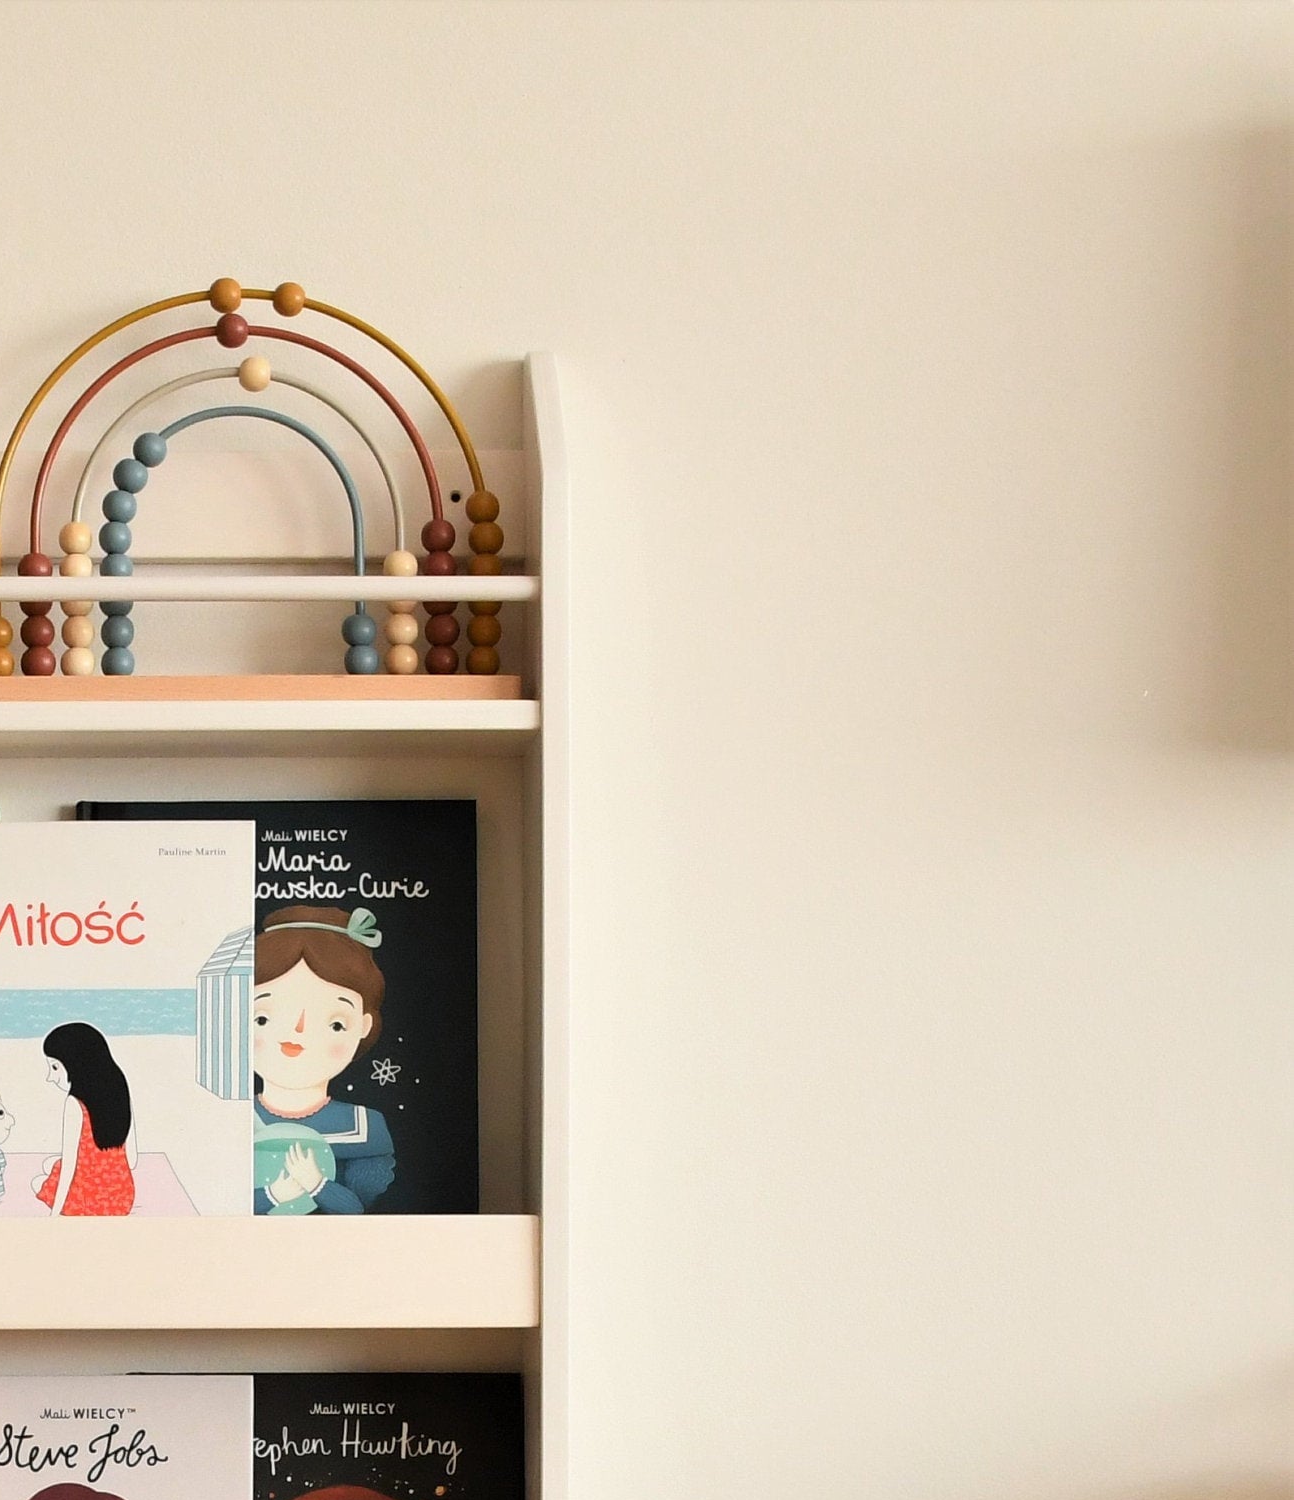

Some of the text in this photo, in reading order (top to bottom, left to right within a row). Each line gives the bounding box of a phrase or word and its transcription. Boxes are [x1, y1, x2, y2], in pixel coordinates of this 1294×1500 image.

[261, 829, 348, 841] Mali WIELCY
[158, 847, 227, 857] Pauline Martin
[258, 846, 351, 872] Maria
[255, 872, 429, 899] owska-Curie
[40, 1408, 70, 1419] Mali
[309, 1403, 396, 1415] Mali WIELCY
[87, 1424, 168, 1482] Jobs
[340, 1418, 463, 1475] Hawking
